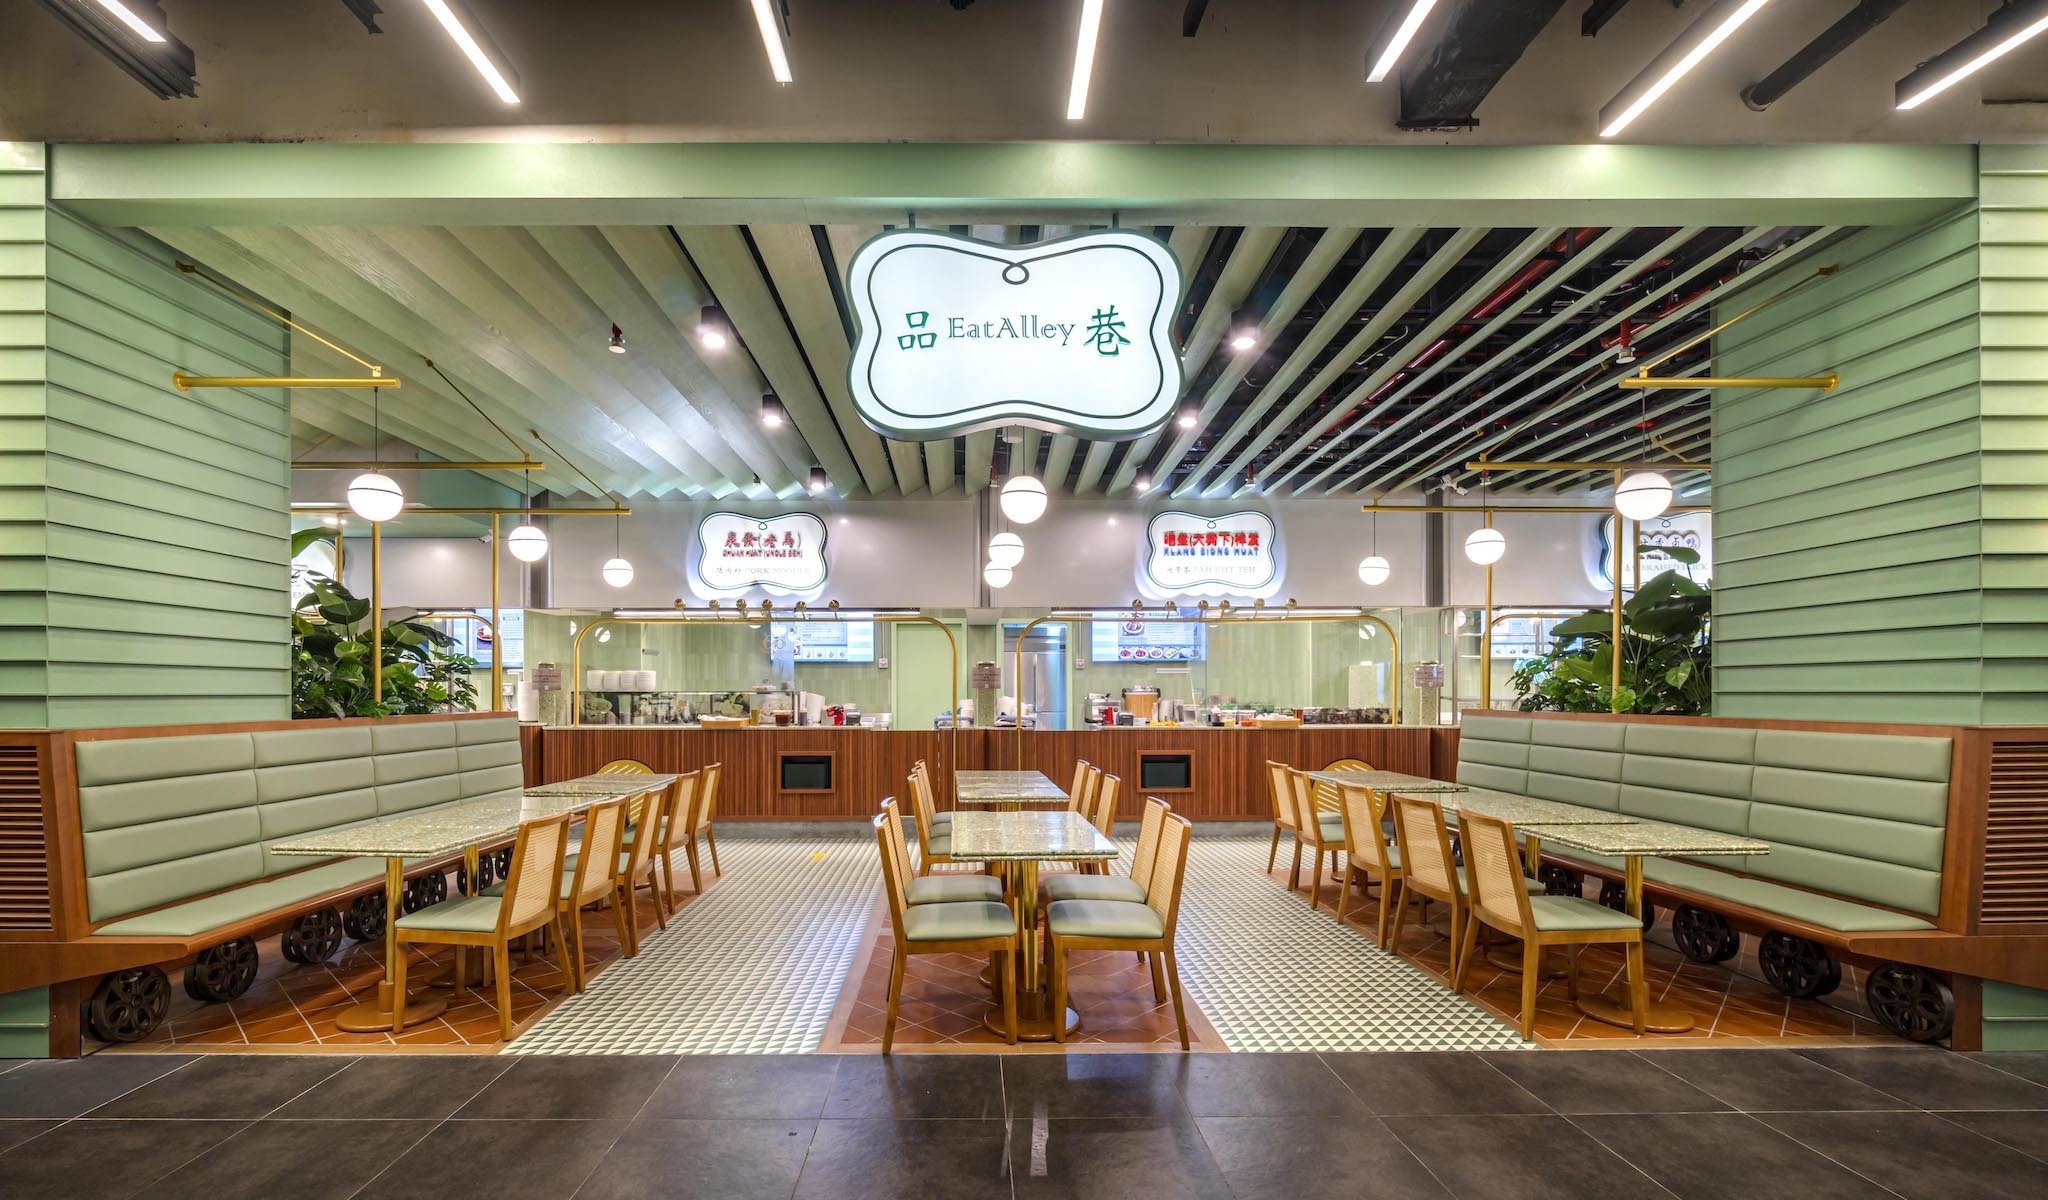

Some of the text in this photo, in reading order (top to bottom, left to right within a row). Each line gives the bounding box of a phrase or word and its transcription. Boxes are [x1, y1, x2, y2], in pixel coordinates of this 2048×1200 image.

[897, 304, 1132, 357] 品 EatAlley 巷
